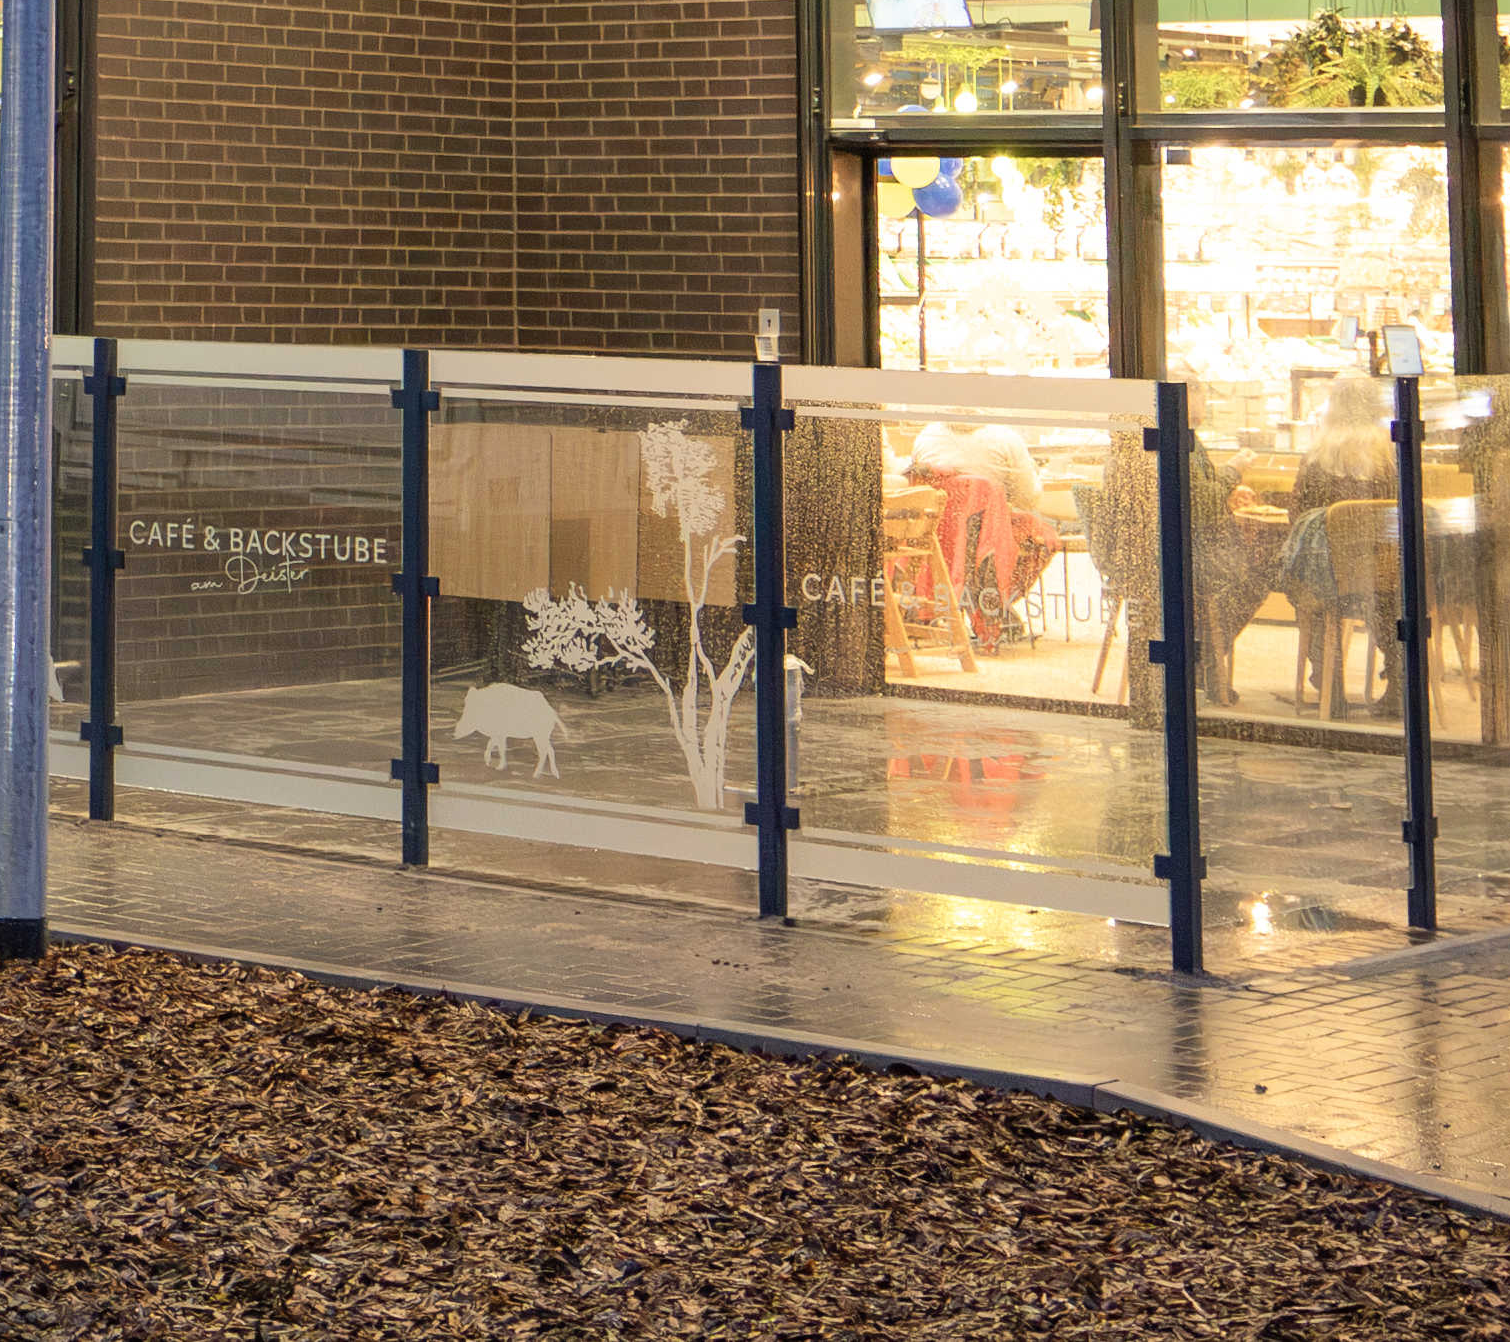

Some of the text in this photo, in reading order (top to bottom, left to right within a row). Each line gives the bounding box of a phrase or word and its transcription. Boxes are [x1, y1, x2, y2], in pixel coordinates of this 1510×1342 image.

[129, 518, 389, 564] CAFÉ & BACKSTUBE
[801, 570, 885, 607] CAFÉ
